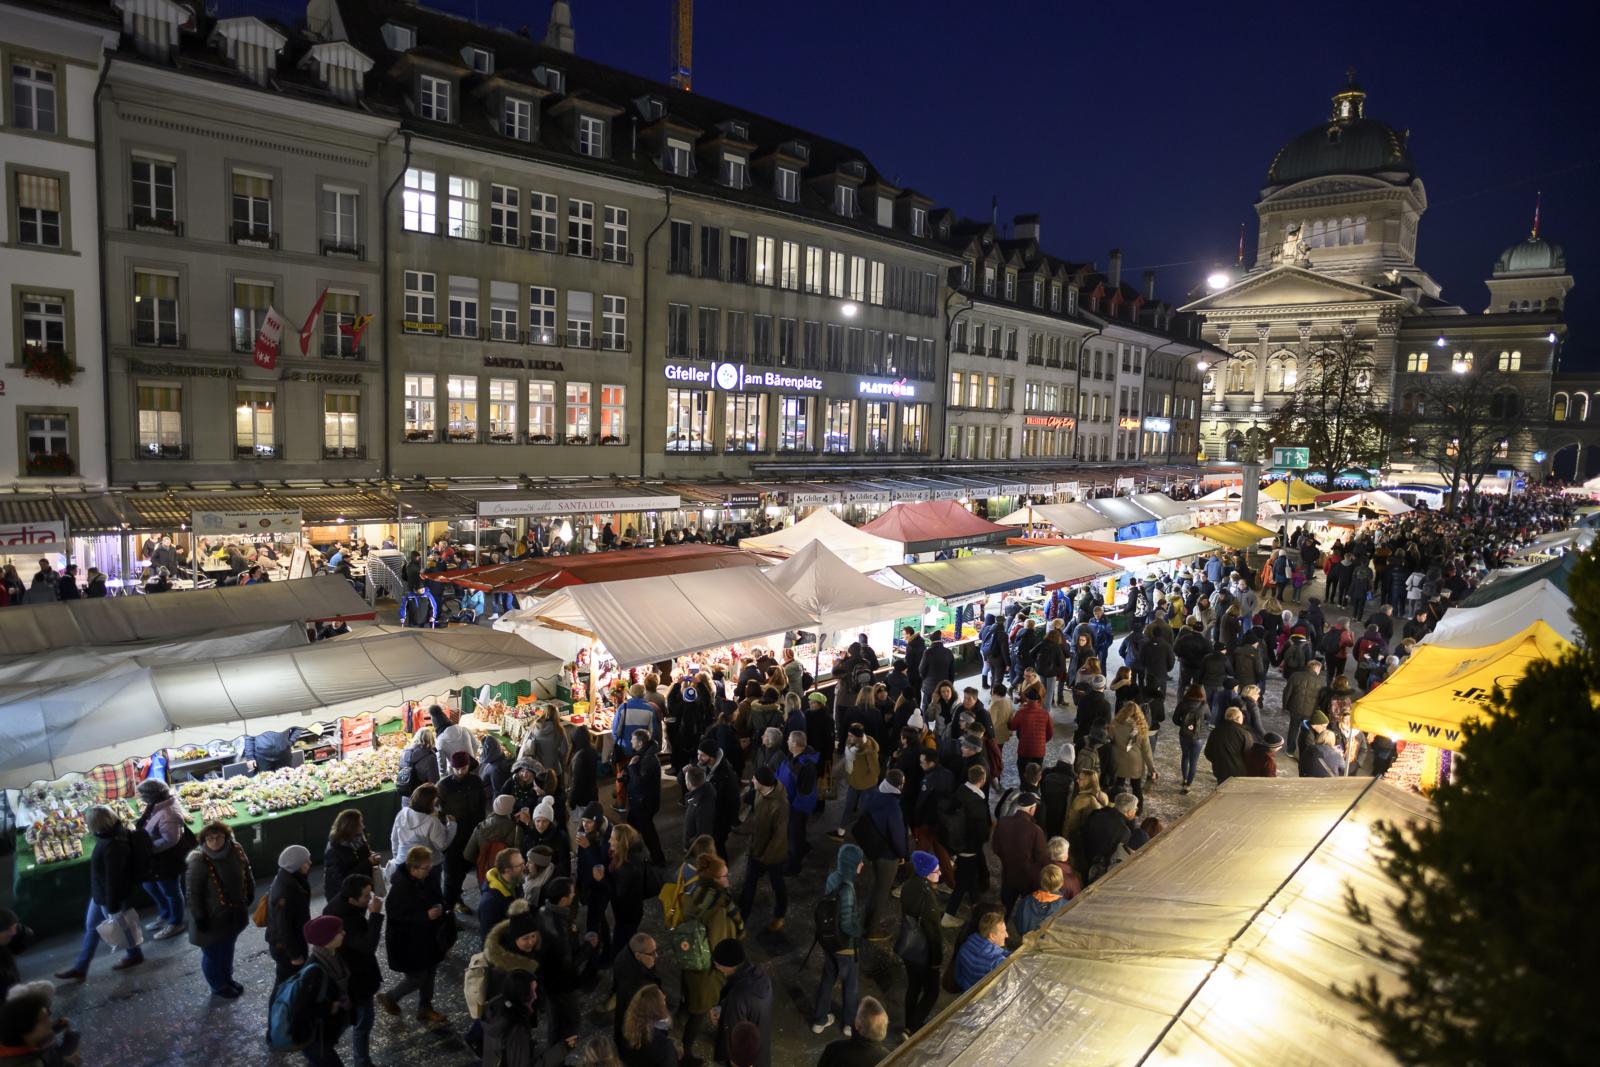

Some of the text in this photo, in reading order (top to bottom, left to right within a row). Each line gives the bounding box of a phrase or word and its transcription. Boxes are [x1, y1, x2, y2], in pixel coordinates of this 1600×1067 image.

[483, 356, 564, 371] SANTA LUCIA
[664, 365, 823, 390] Gfeller am Bärenplatz
[558, 502, 588, 510] SANTA
[589, 501, 615, 509] LUCIA
[0, 526, 56, 545] dia
